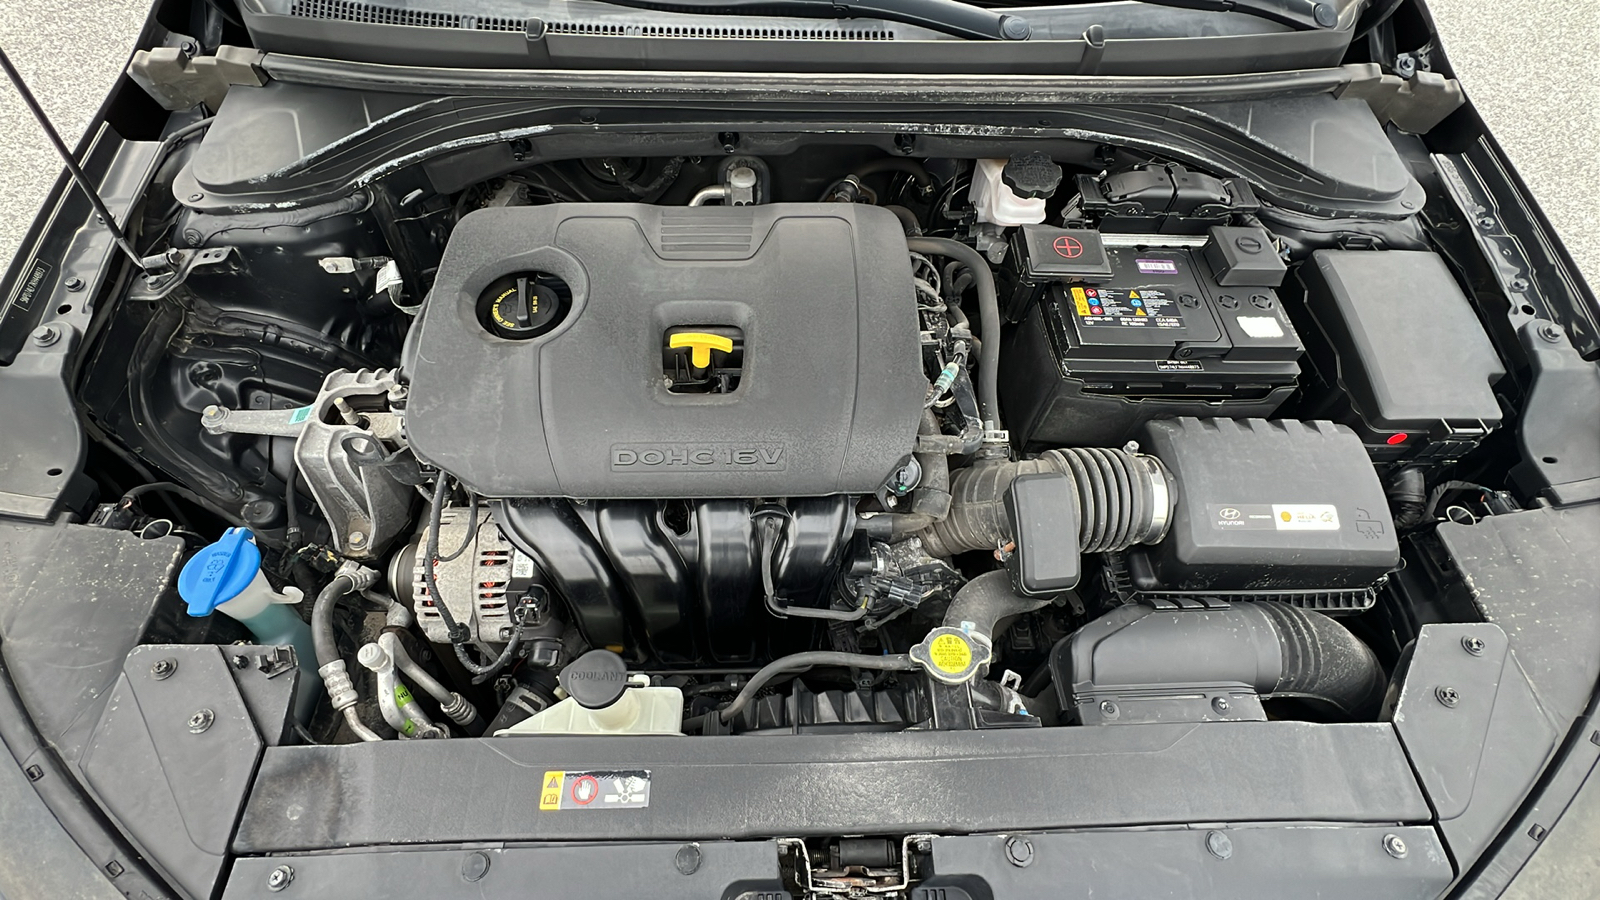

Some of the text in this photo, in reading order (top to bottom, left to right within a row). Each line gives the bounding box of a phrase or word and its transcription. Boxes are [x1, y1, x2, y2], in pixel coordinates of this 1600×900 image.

[495, 287, 517, 303] MANUAL
[614, 448, 784, 466] DOHC 16V
[570, 670, 627, 682] COOLANT
[397, 690, 409, 701] NU
